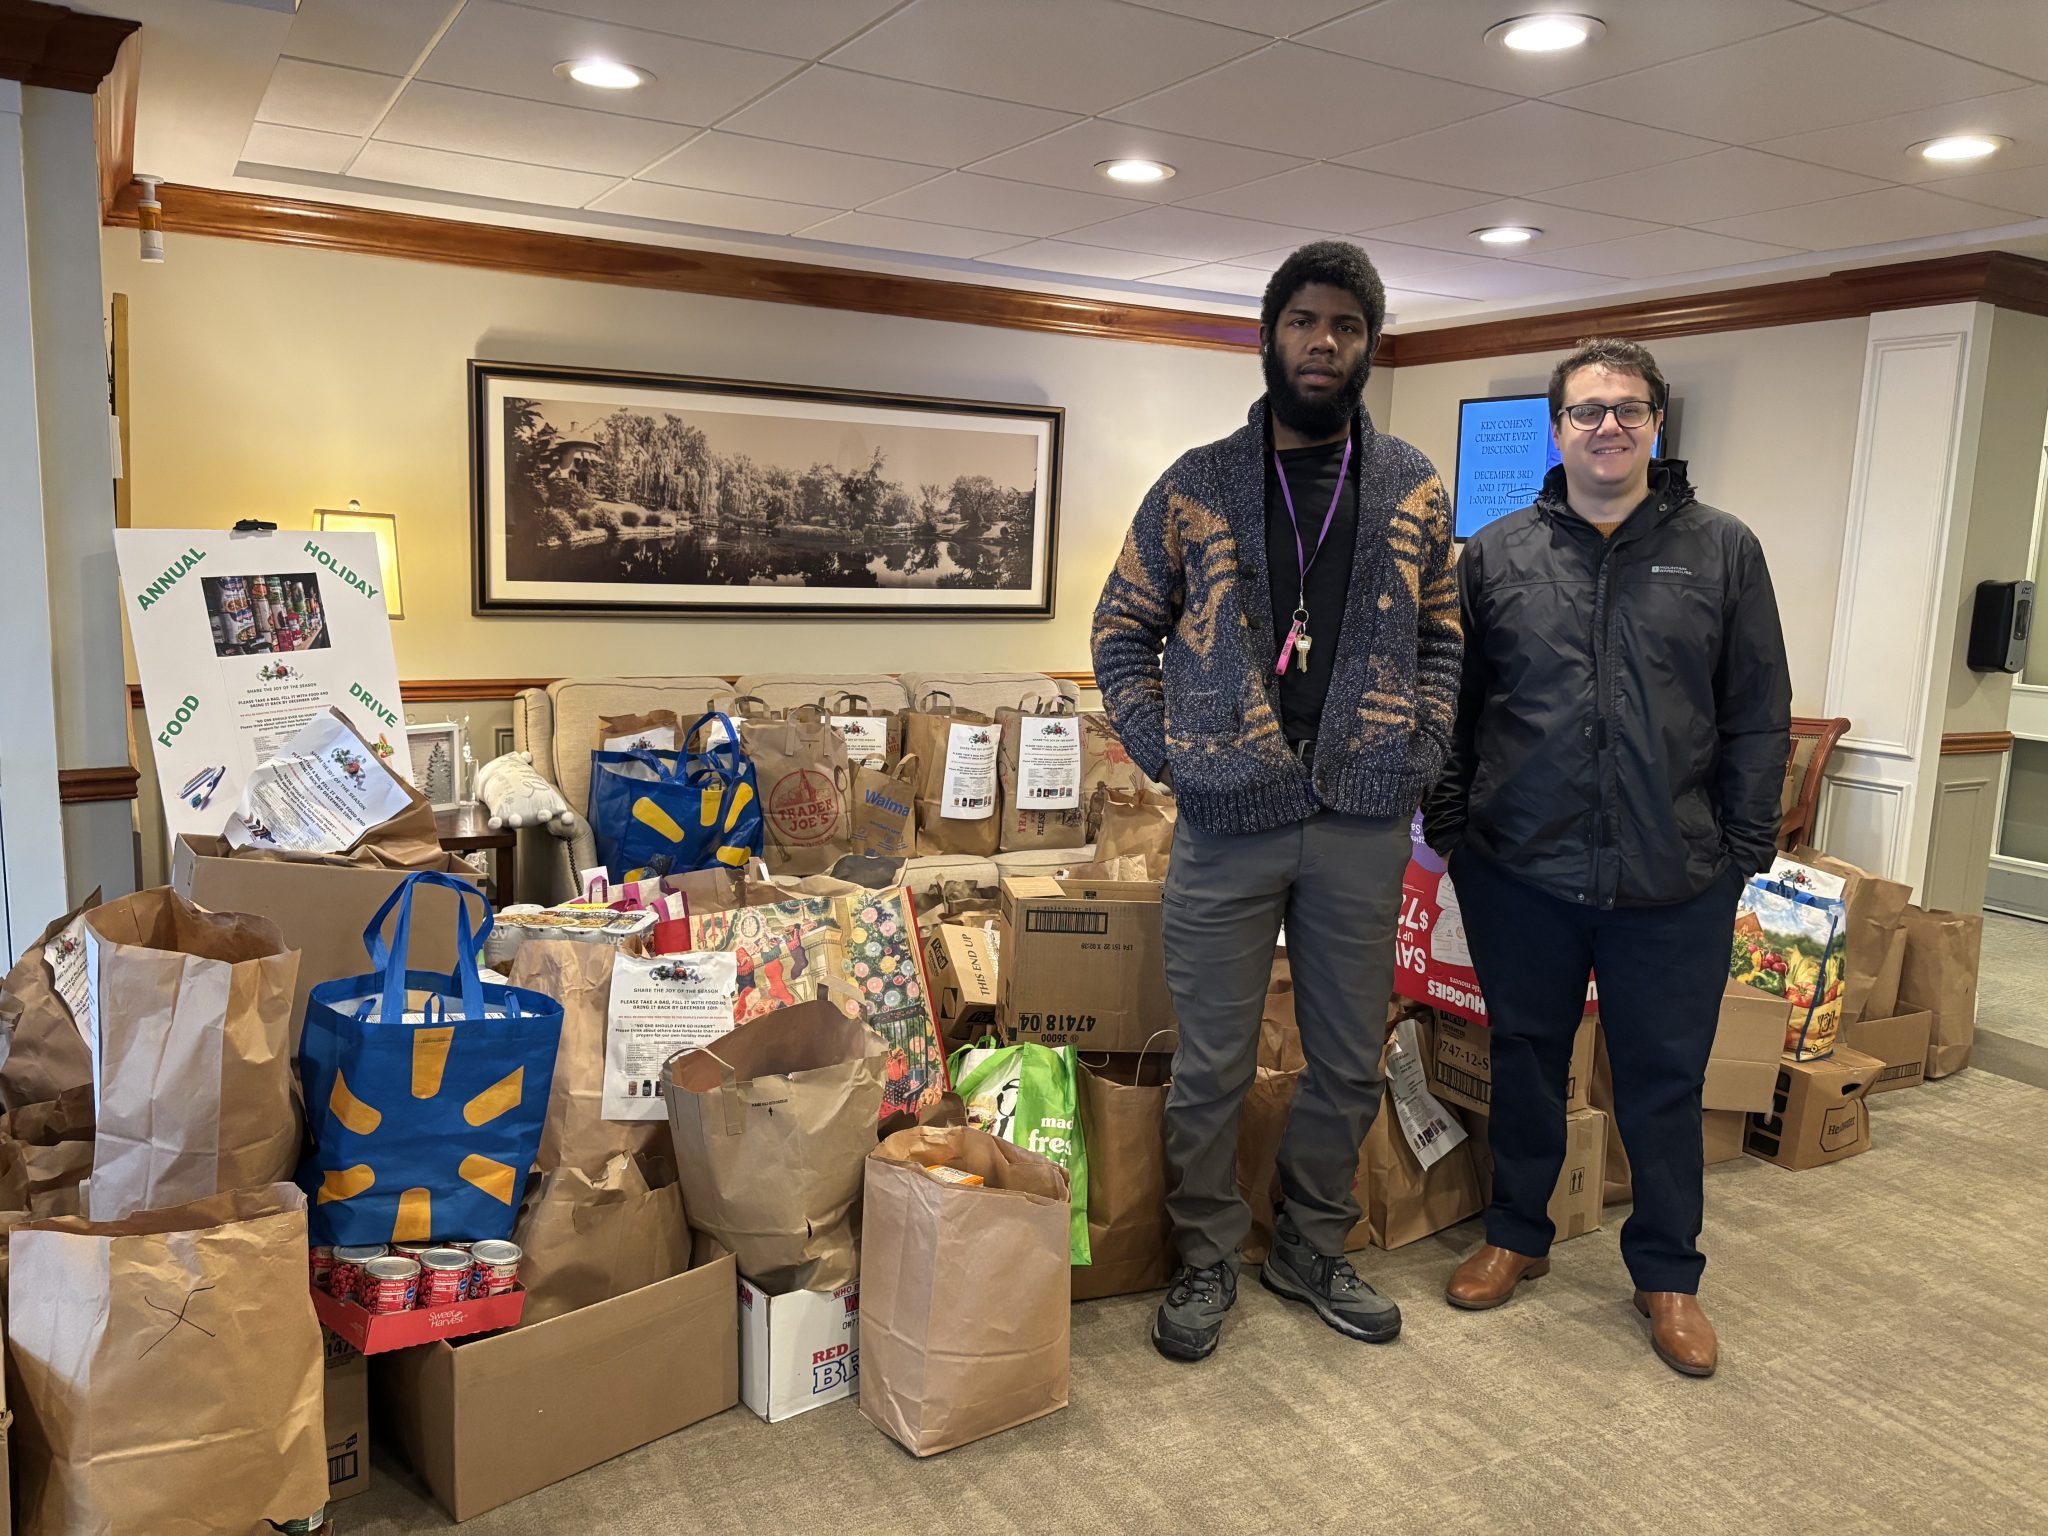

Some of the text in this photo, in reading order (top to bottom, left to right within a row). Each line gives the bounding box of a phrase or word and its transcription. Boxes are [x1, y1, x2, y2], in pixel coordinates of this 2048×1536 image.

[1481, 419, 1532, 430] KEN COHEN'S
[1475, 432, 1537, 443] CURRENT EVENT
[1482, 445, 1528, 454] DISCUSSION
[1474, 470, 1533, 479] DECEMBER 3RD
[1477, 484, 1494, 492] AND
[1470, 496, 1495, 504] 1:00PM
[1498, 496, 1506, 504] IN
[1510, 496, 1524, 504] THE
[304, 540, 379, 600] HOLIDAY
[137, 547, 207, 612] ANNUAL
[349, 682, 398, 728] DRIVE
[157, 694, 201, 749] FOOD
[321, 781, 330, 791] FILL
[335, 795, 346, 805] WITH
[345, 805, 358, 817] FOOD
[356, 817, 366, 826] AND
[322, 790, 343, 813] DECEMBER
[340, 783, 349, 794] THE
[348, 792, 366, 810] SEASON
[778, 799, 834, 820] TRADER
[789, 813, 829, 832] JOE'S
[962, 933, 973, 948] UP
[1403, 931, 1414, 943] UP
[968, 950, 982, 971] END
[974, 973, 990, 996] THIS
[1450, 977, 1471, 988] movers
[1427, 980, 1486, 1015] HUGGIES
[1020, 1014, 1096, 1032] 47418 04
[1041, 1034, 1067, 1043] 36000
[1040, 1116, 1074, 1130] mad
[1028, 1129, 1072, 1155] fres
[429, 1310, 456, 1321] Sweet
[431, 1315, 464, 1328] Harvest
[812, 1343, 848, 1365] RED
